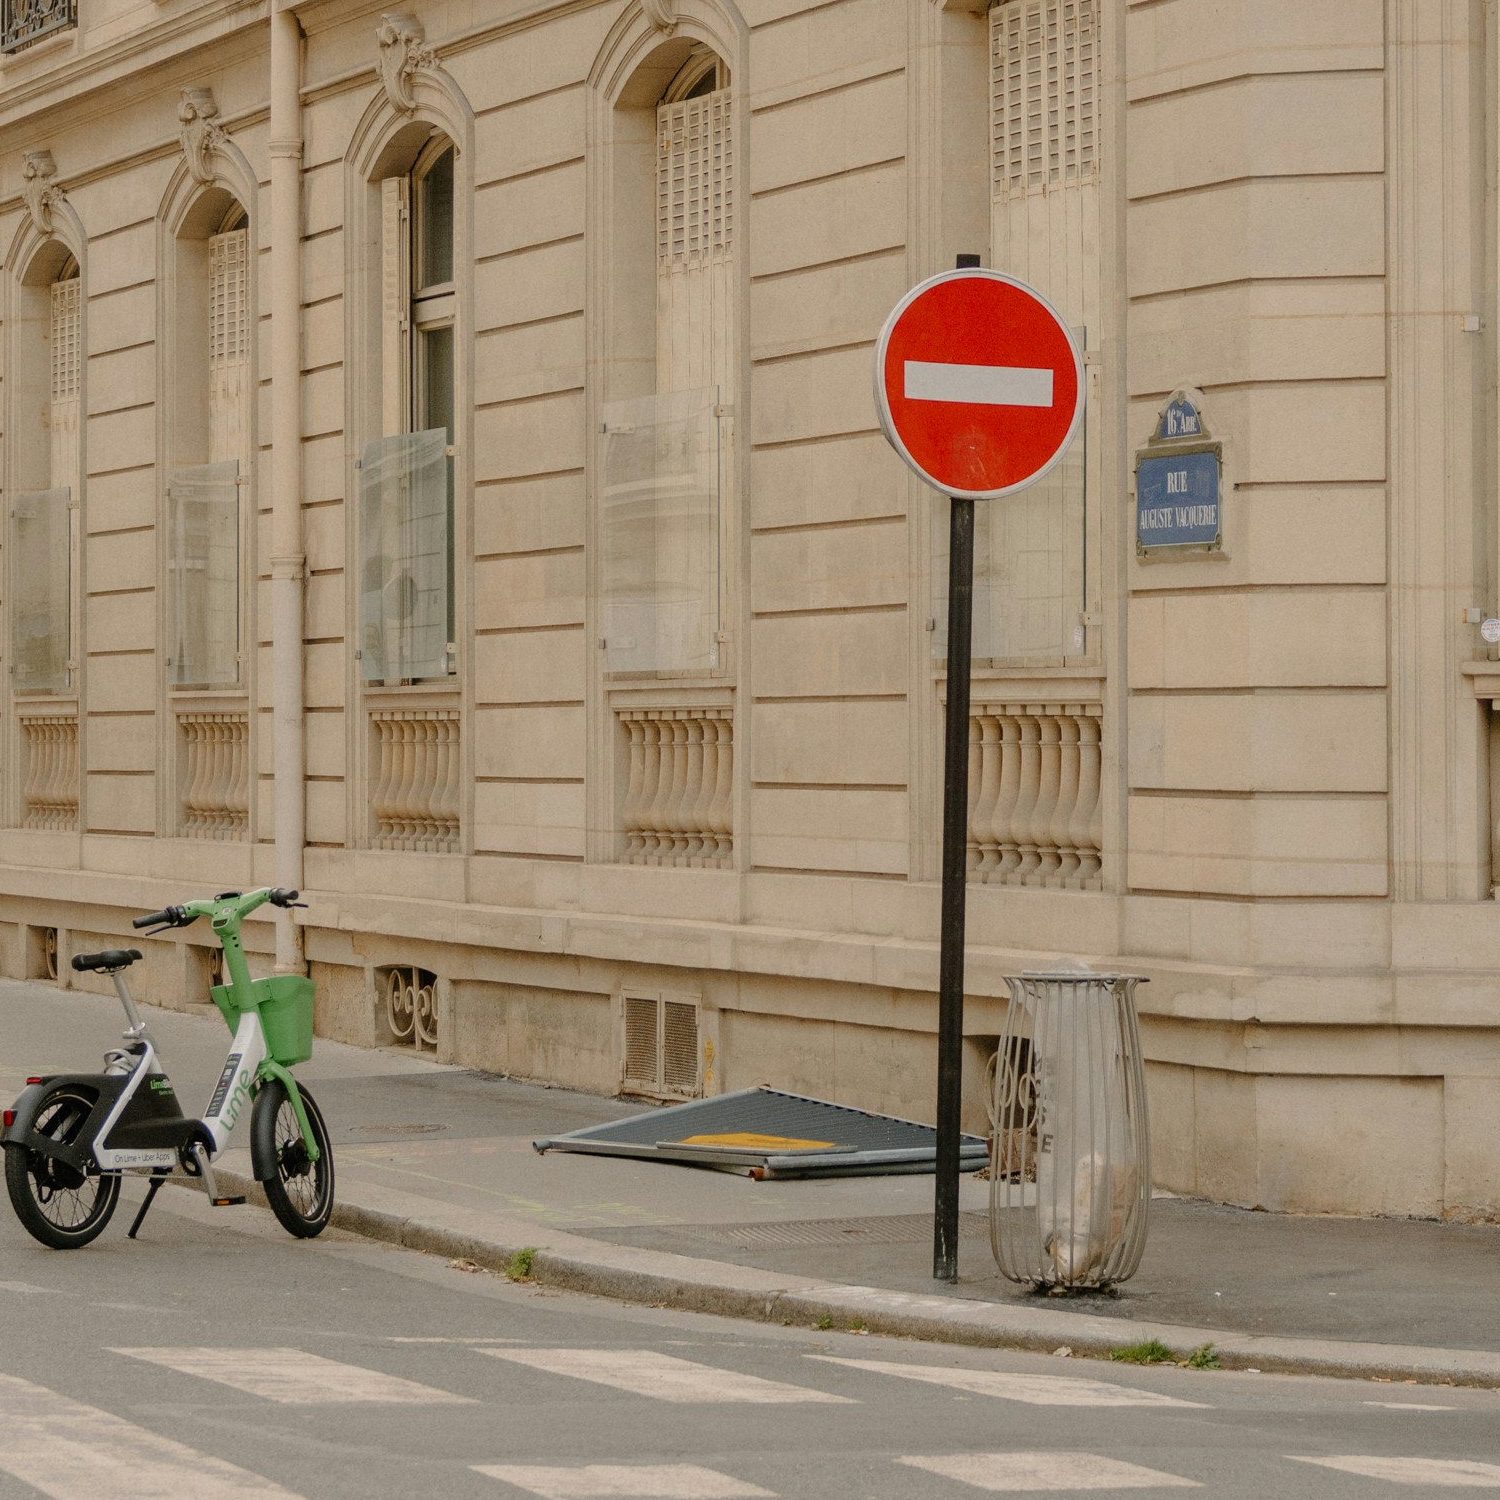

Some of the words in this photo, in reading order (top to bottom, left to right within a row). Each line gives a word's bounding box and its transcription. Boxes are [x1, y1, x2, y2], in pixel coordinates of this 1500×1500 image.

[1167, 471, 1188, 494] RUE
[1139, 507, 1173, 530] AUGUSTE
[1175, 504, 1217, 529] VACQUERIE
[220, 1069, 252, 1132] Lime
